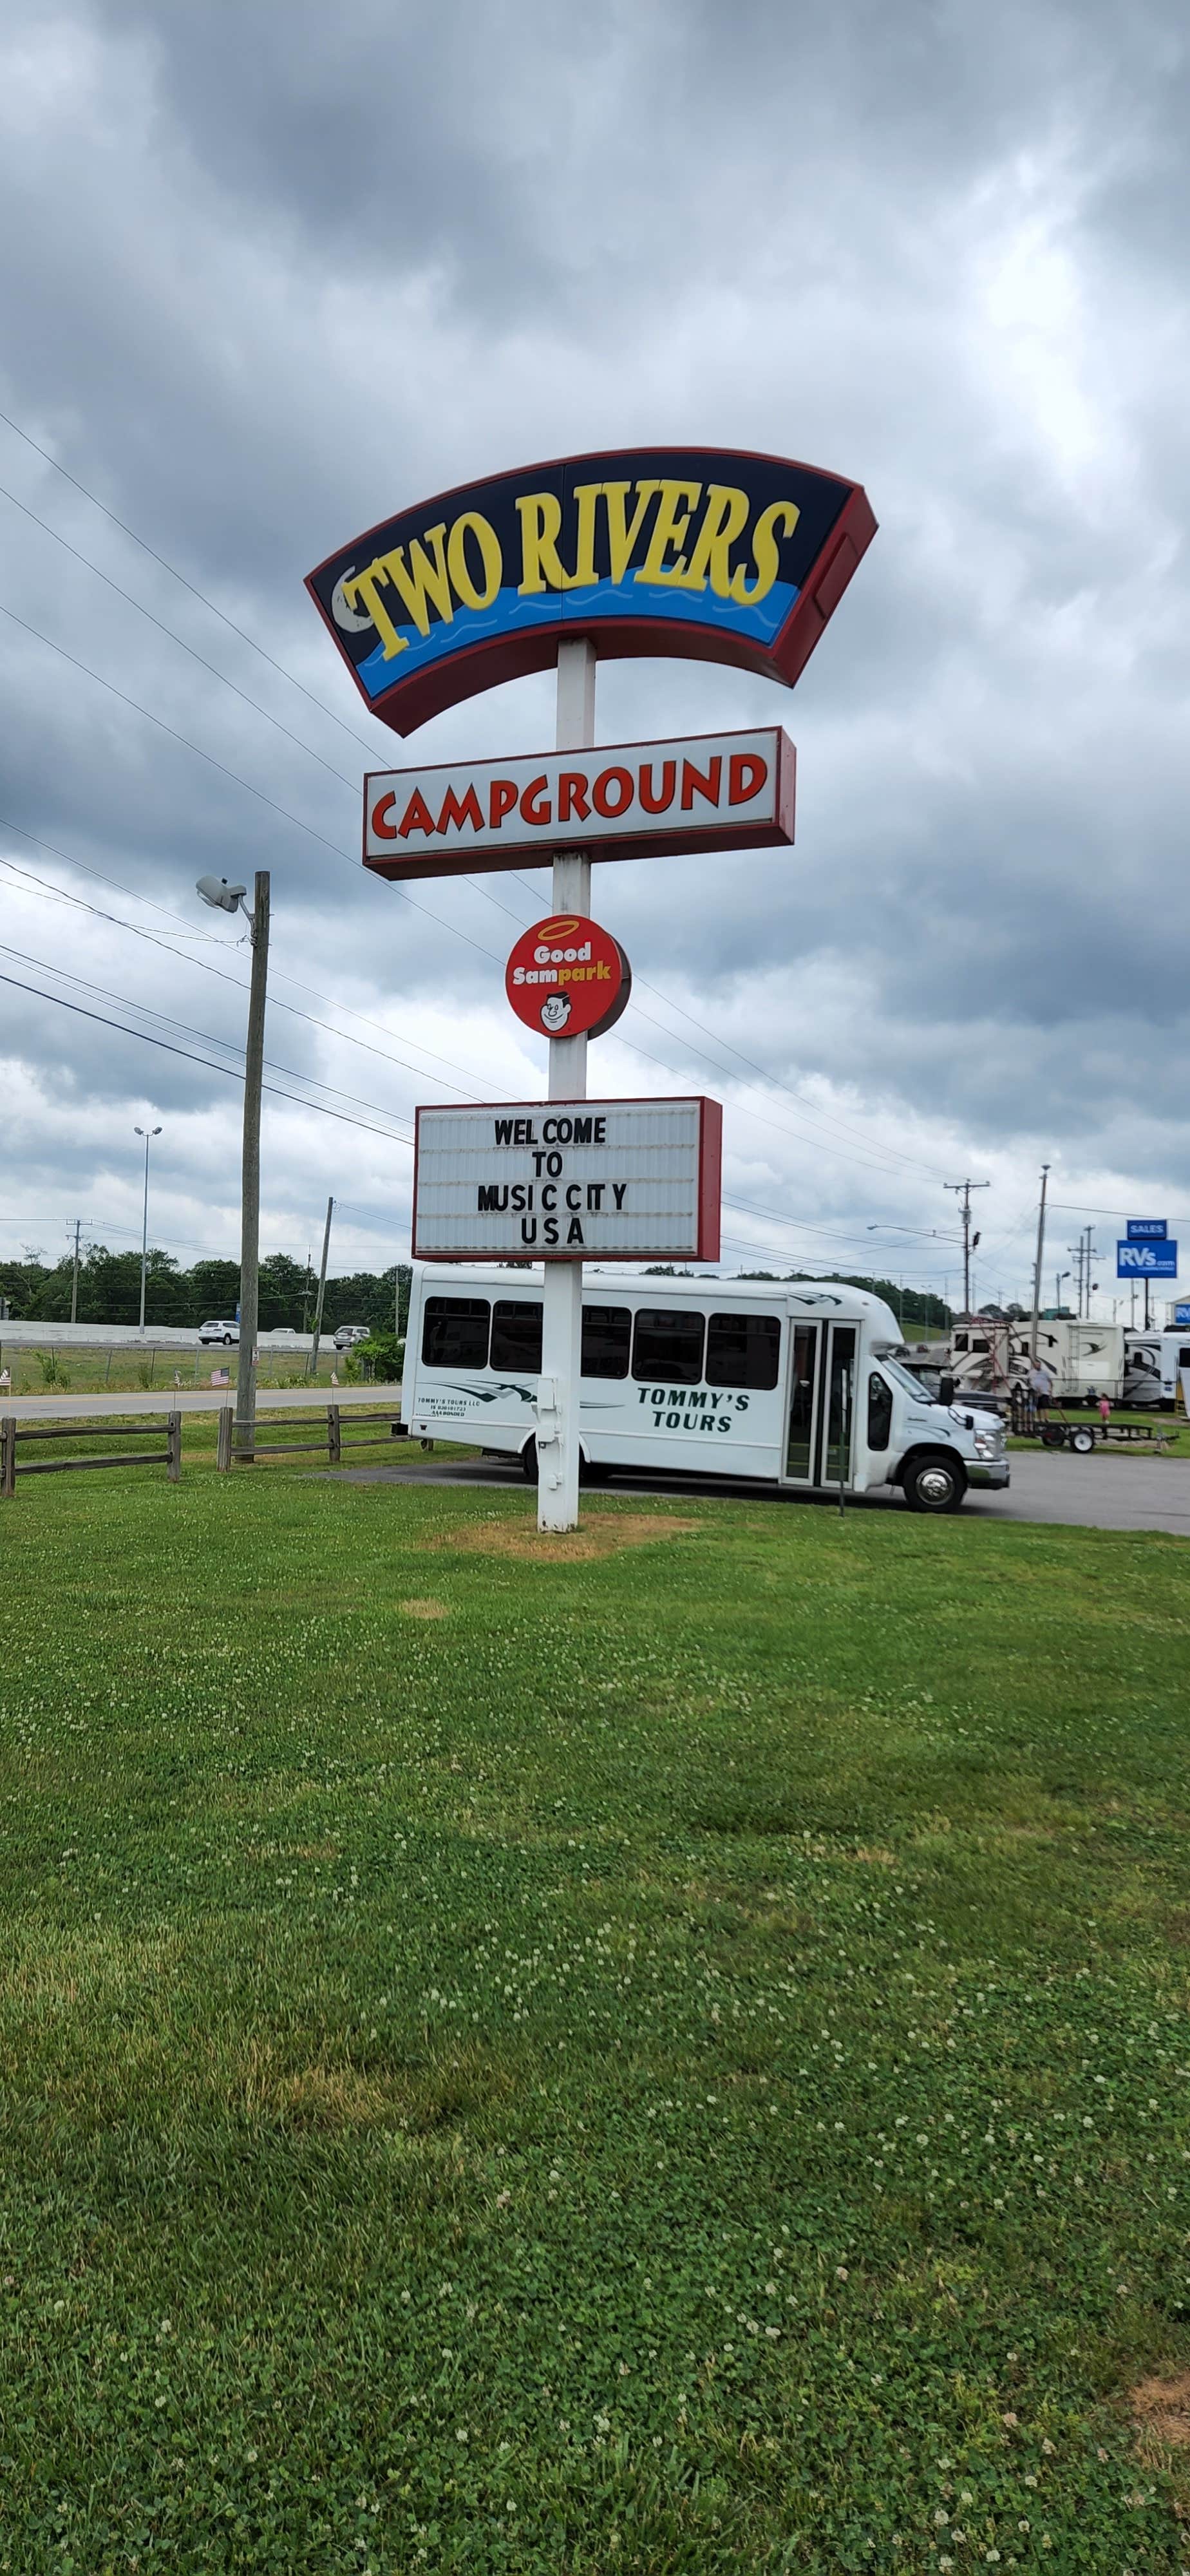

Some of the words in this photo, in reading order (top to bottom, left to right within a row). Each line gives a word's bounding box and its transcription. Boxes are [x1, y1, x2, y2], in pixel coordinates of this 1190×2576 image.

[342, 511, 503, 661] TWO
[516, 479, 800, 606] RIVERS
[372, 753, 768, 839] CAMPGROUND
[534, 942, 591, 964] Good
[495, 1117, 606, 1145] WELCOME
[532, 1151, 562, 1177] TO
[478, 1184, 558, 1211] MUSIC
[565, 1184, 627, 1211] CITY
[522, 1217, 584, 1244] USA
[1130, 1225, 1164, 1233] SALES
[638, 1387, 750, 1411] TOMMY'S
[652, 1411, 732, 1432] TOURS
